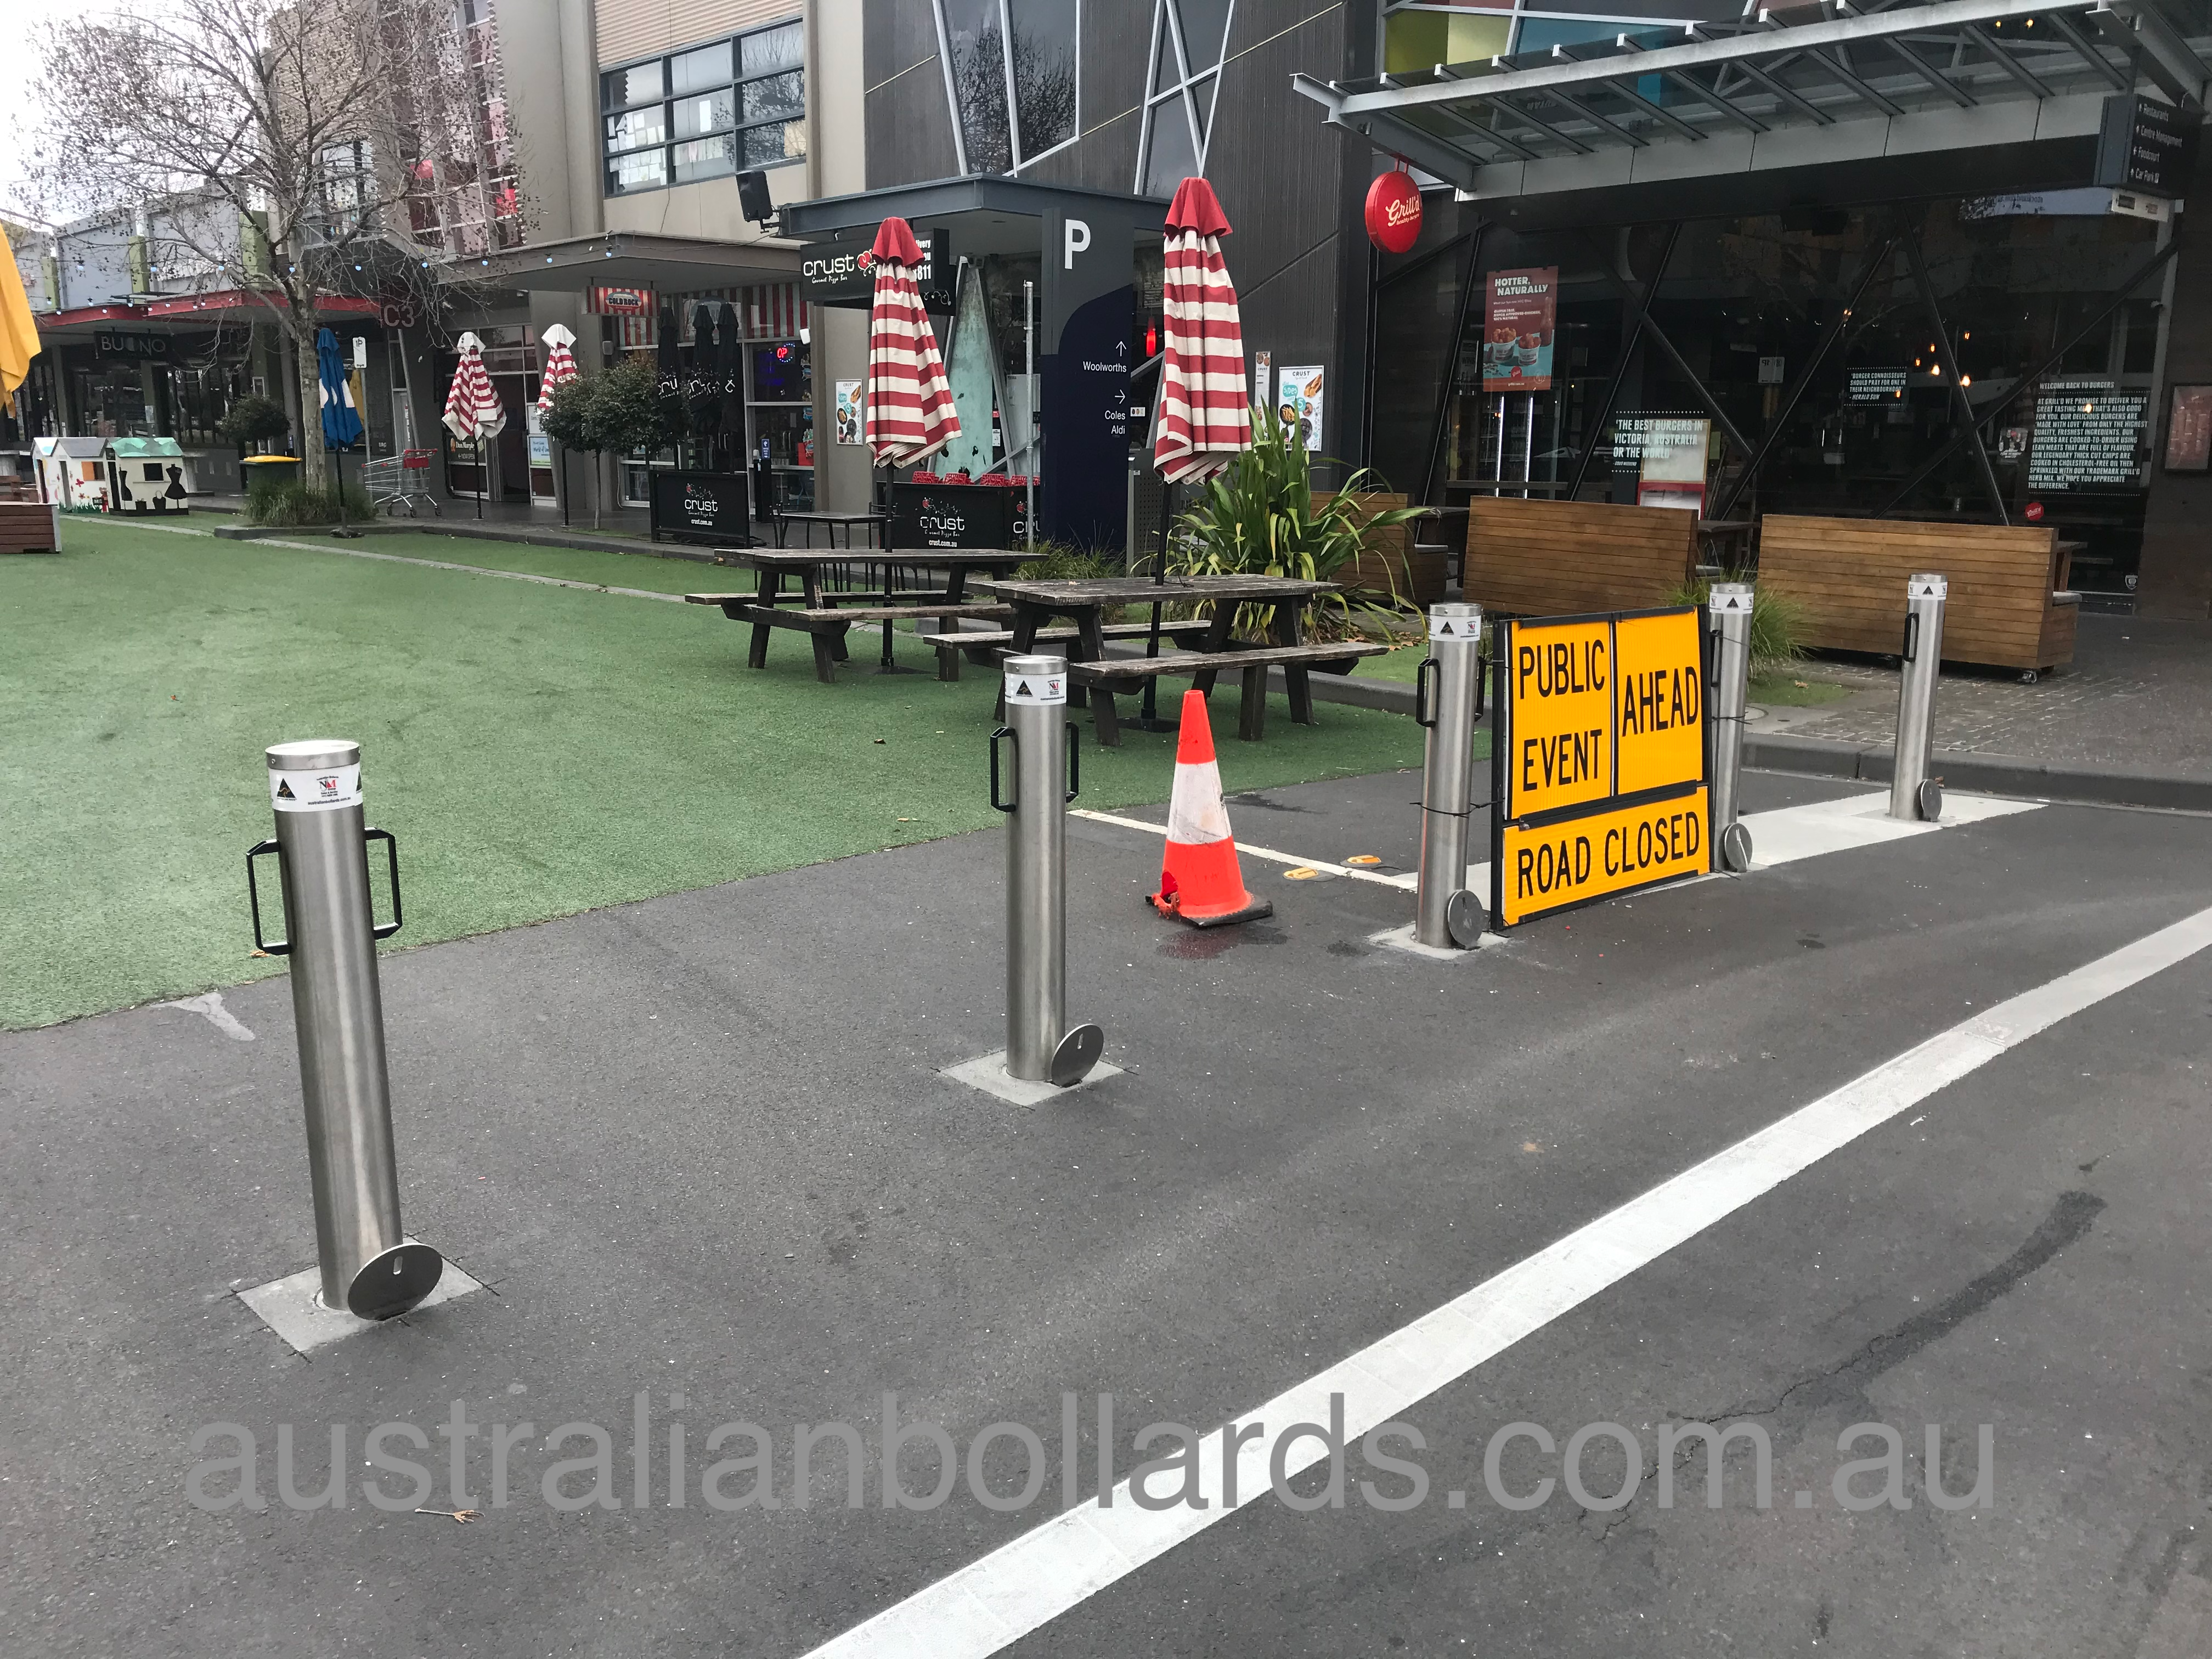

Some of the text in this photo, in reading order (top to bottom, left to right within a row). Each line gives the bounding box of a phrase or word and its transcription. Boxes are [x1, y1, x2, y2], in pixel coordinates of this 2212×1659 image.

[1065, 219, 1091, 269] P
[804, 254, 854, 276] crust
[828, 275, 839, 284] Pizza
[1495, 276, 1530, 286] HOTTER,
[1497, 284, 1548, 296] NATURALLY
[384, 304, 414, 328] C3
[1083, 361, 1126, 372] Woolworths
[1105, 410, 1125, 420] Coles
[1111, 425, 1125, 435] Aldi
[1634, 420, 1654, 431] BEST
[1656, 420, 1692, 431] BURGERS
[1695, 420, 1703, 431] IN
[1615, 433, 1697, 445] VICTORIA, AUSTRALIA
[1613, 447, 1624, 458] OR
[1626, 447, 1640, 458] THE
[685, 499, 718, 511] crust
[920, 516, 965, 531] crust
[1519, 639, 1605, 700] PUBLIC
[1622, 666, 1699, 737] AHEAD
[1523, 729, 1602, 792] EVENT
[1518, 811, 1700, 899] ROAD CLOSED
